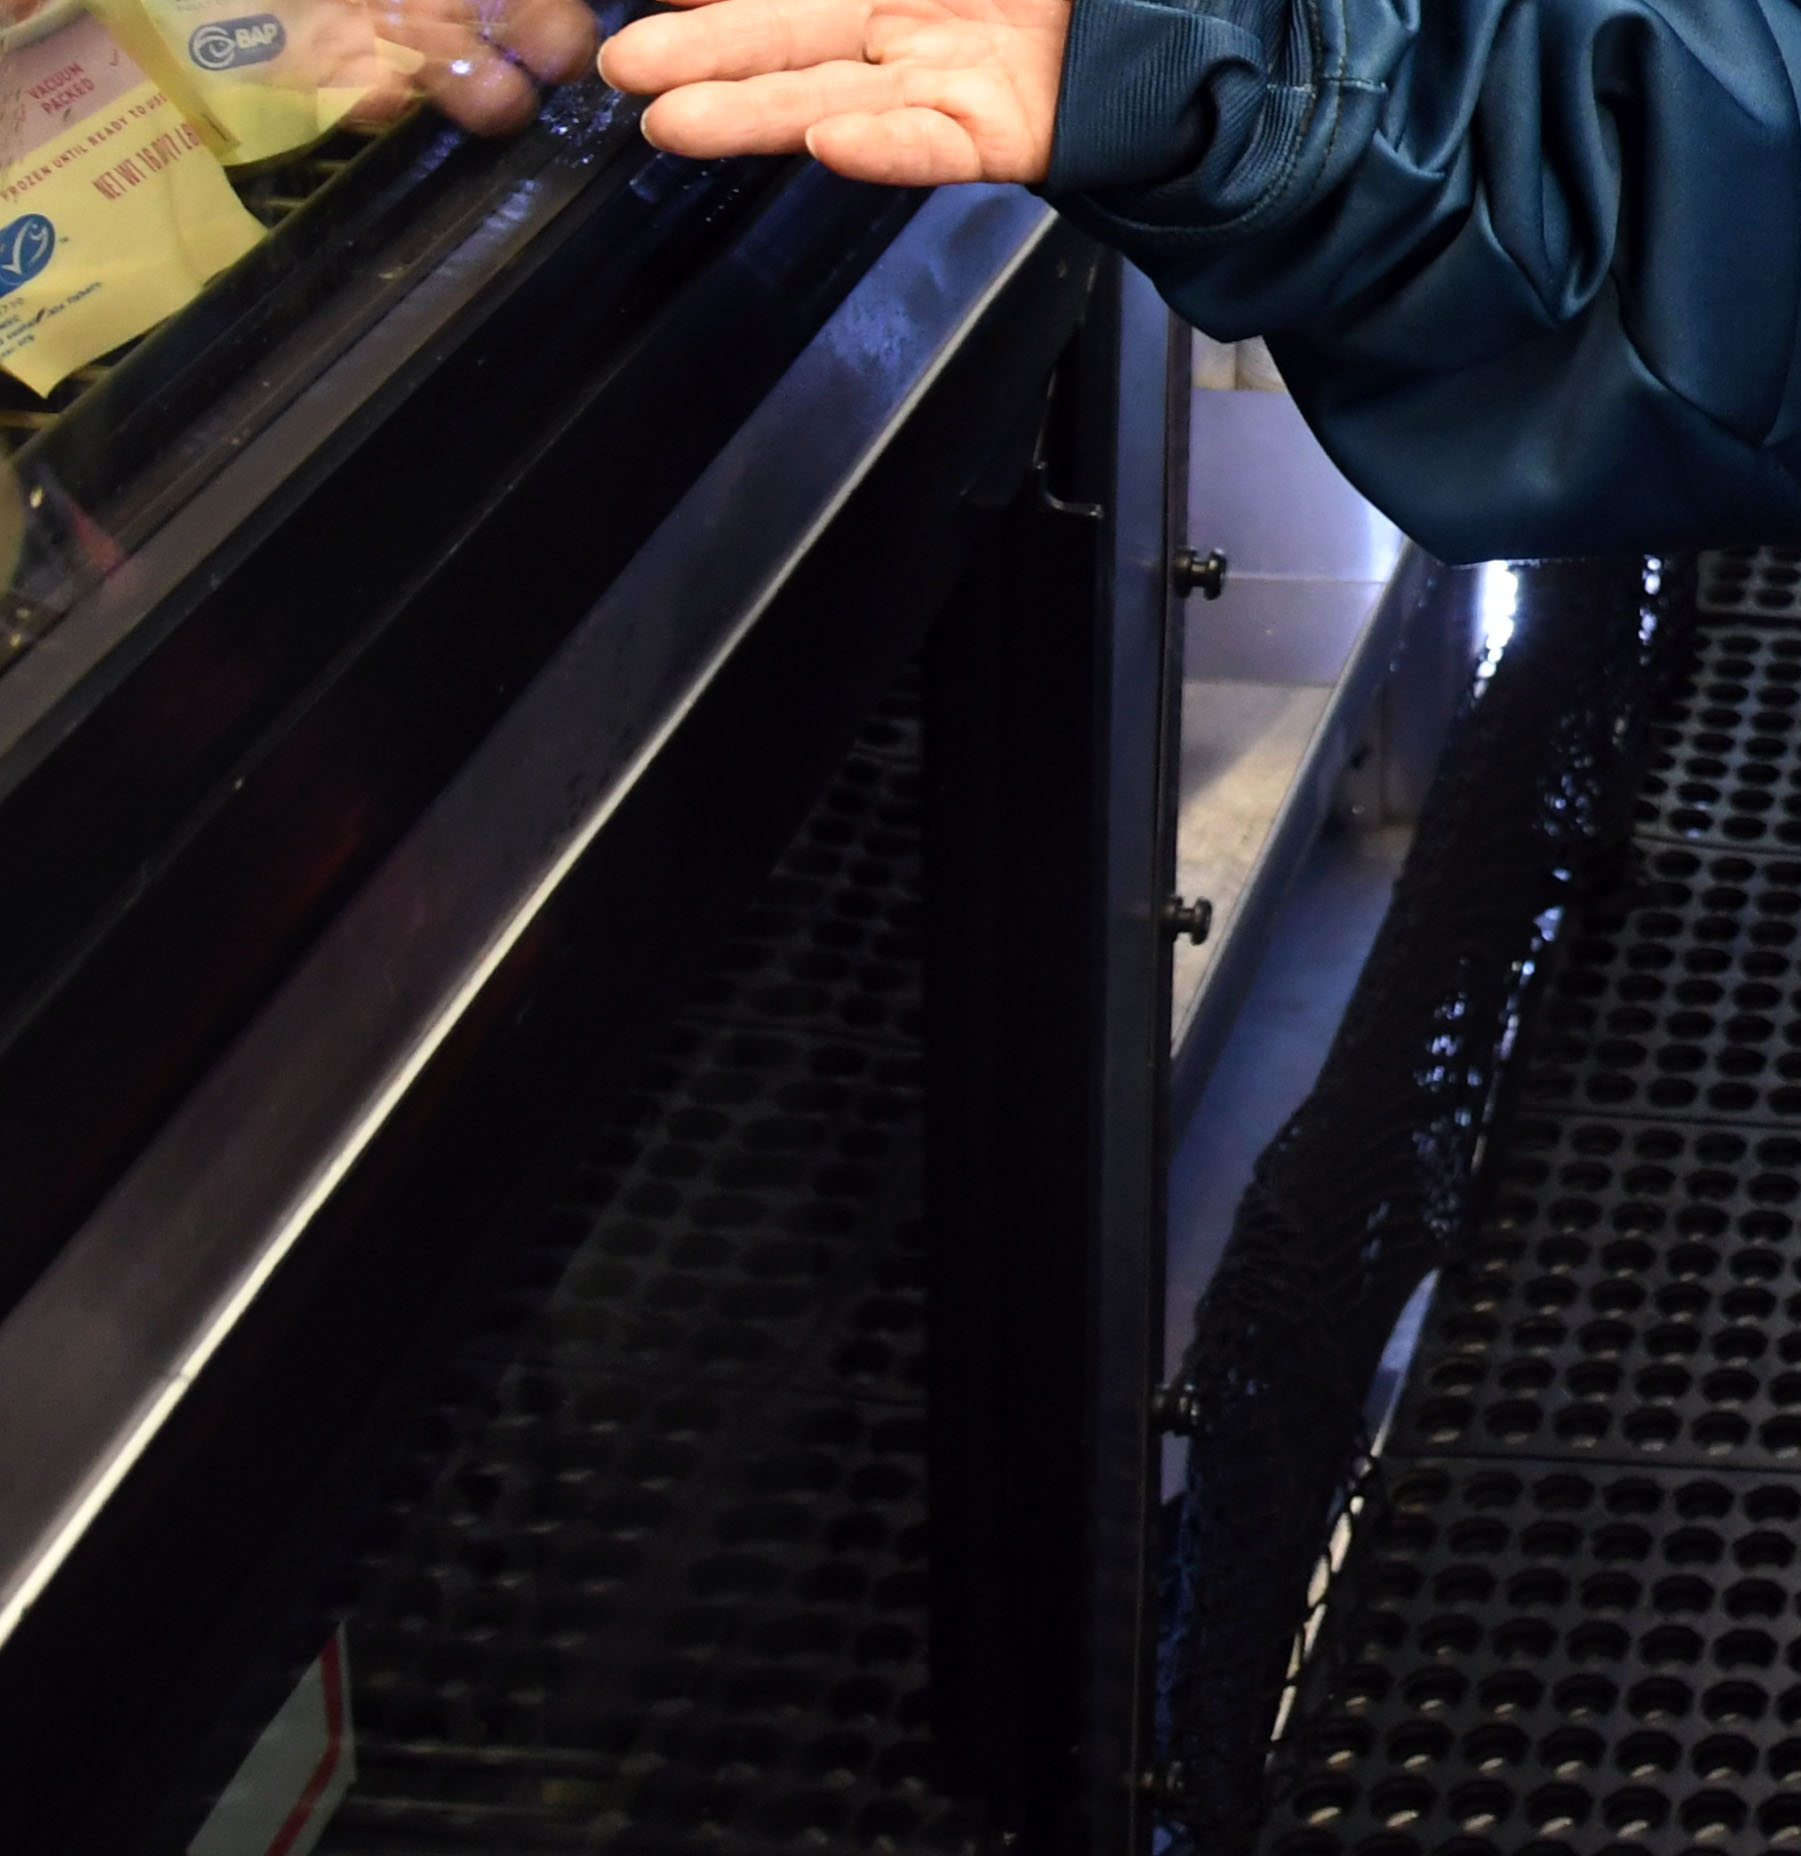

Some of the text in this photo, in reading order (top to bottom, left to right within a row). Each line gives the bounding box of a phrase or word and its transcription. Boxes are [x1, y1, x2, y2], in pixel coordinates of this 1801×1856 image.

[235, 23, 279, 49] BAP
[27, 61, 86, 101] VACUUM
[40, 77, 97, 116] PACKED
